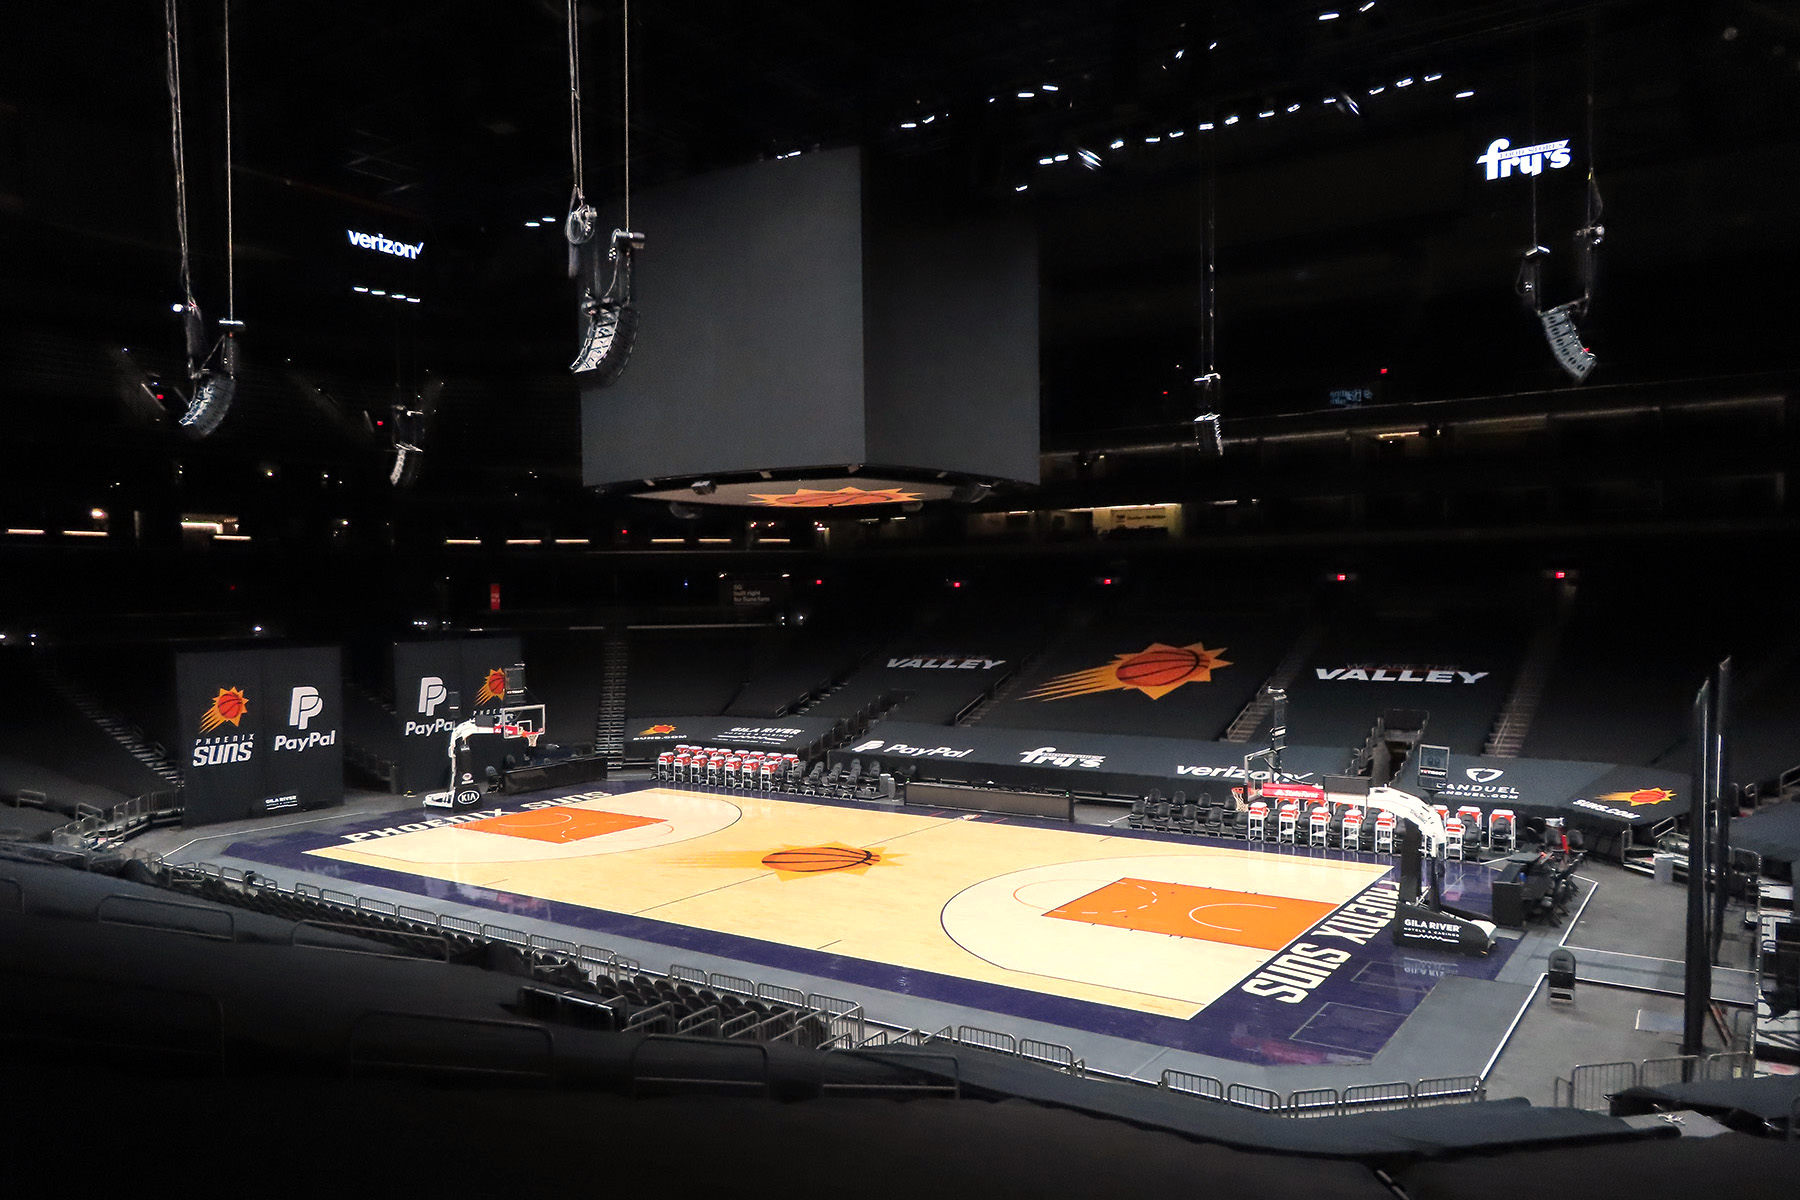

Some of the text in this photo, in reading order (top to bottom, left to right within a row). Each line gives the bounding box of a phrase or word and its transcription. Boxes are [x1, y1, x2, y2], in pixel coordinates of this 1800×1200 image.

[1476, 138, 1571, 181] fry's
[347, 229, 417, 260] verizon
[887, 658, 1007, 670] VALLEY
[1316, 668, 1490, 684] VALLEY
[195, 733, 256, 746] PHOENIX
[274, 730, 336, 752] PayPal
[192, 741, 254, 767] SUNS
[884, 743, 974, 758] PayPal
[1019, 746, 1107, 768] fry's
[1177, 765, 1291, 782] verizon
[461, 792, 476, 802] KIA
[340, 791, 613, 843] PHOENIX SUNS
[1404, 919, 1460, 933] GILA RIVER
[1241, 943, 1352, 1004] SUNS
